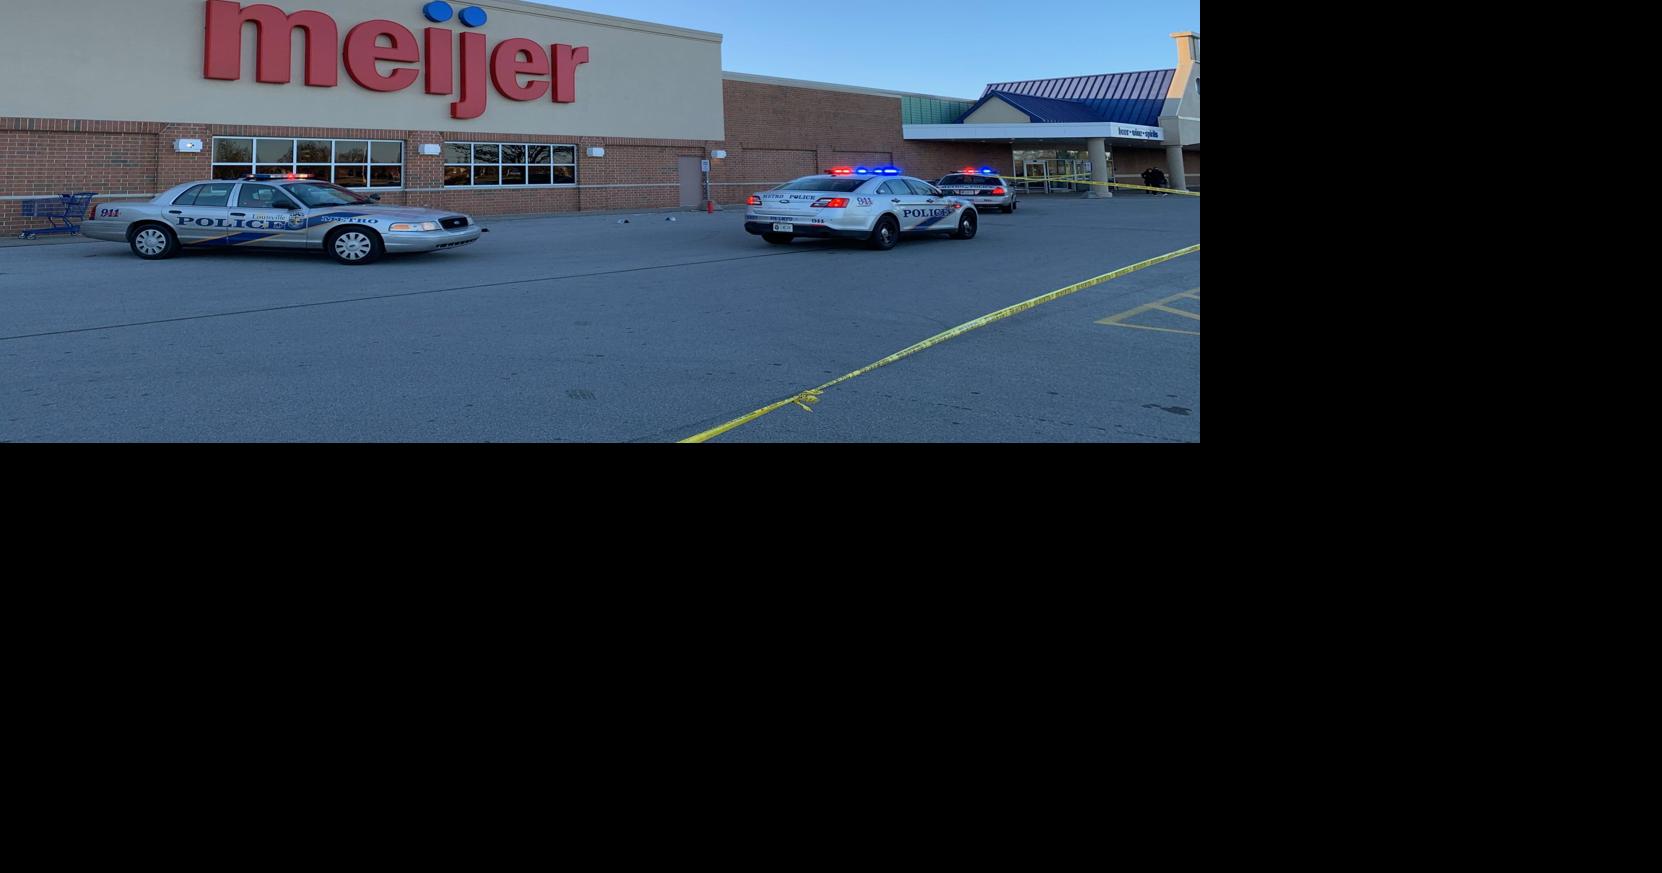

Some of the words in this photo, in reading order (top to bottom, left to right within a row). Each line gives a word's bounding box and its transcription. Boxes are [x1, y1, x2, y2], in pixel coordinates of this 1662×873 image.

[205, 0, 589, 120] meijer
[100, 208, 120, 218] 911
[903, 208, 950, 218] POLICE
[176, 216, 286, 230] POLICE
